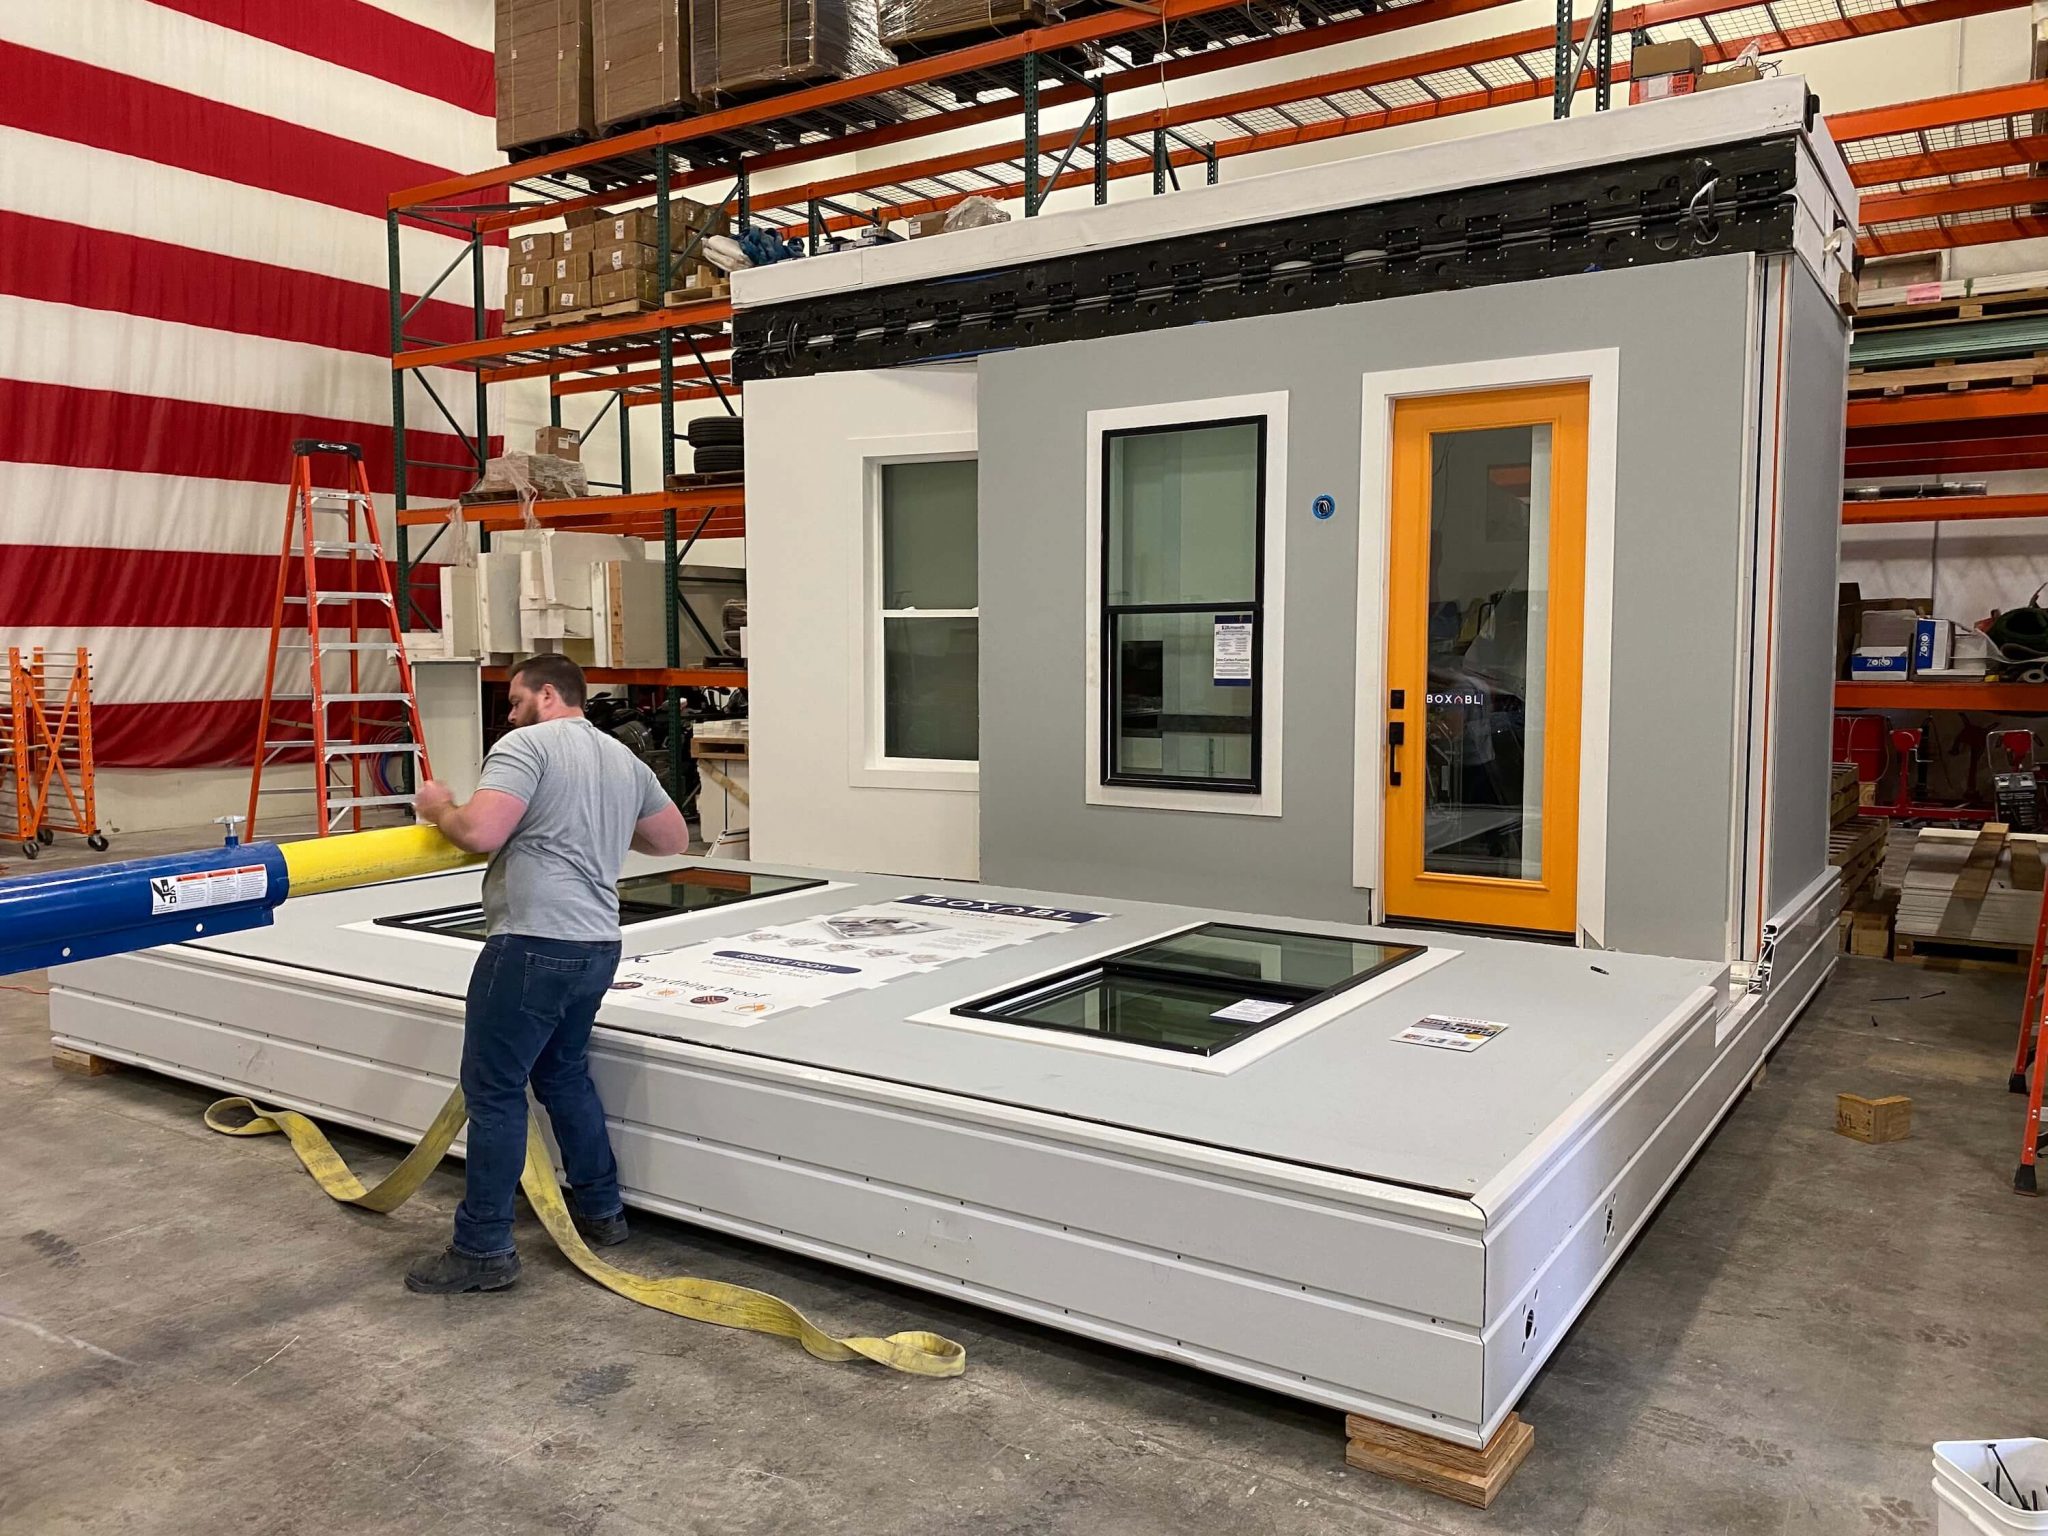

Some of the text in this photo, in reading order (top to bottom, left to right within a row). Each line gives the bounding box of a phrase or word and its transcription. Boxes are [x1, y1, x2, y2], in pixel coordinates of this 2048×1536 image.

[1918, 633, 1930, 657] ZORO
[1866, 658, 1893, 667] ZORO
[920, 897, 1073, 919] BOXABL
[624, 972, 714, 991] Everything
[714, 986, 772, 999] Proof
